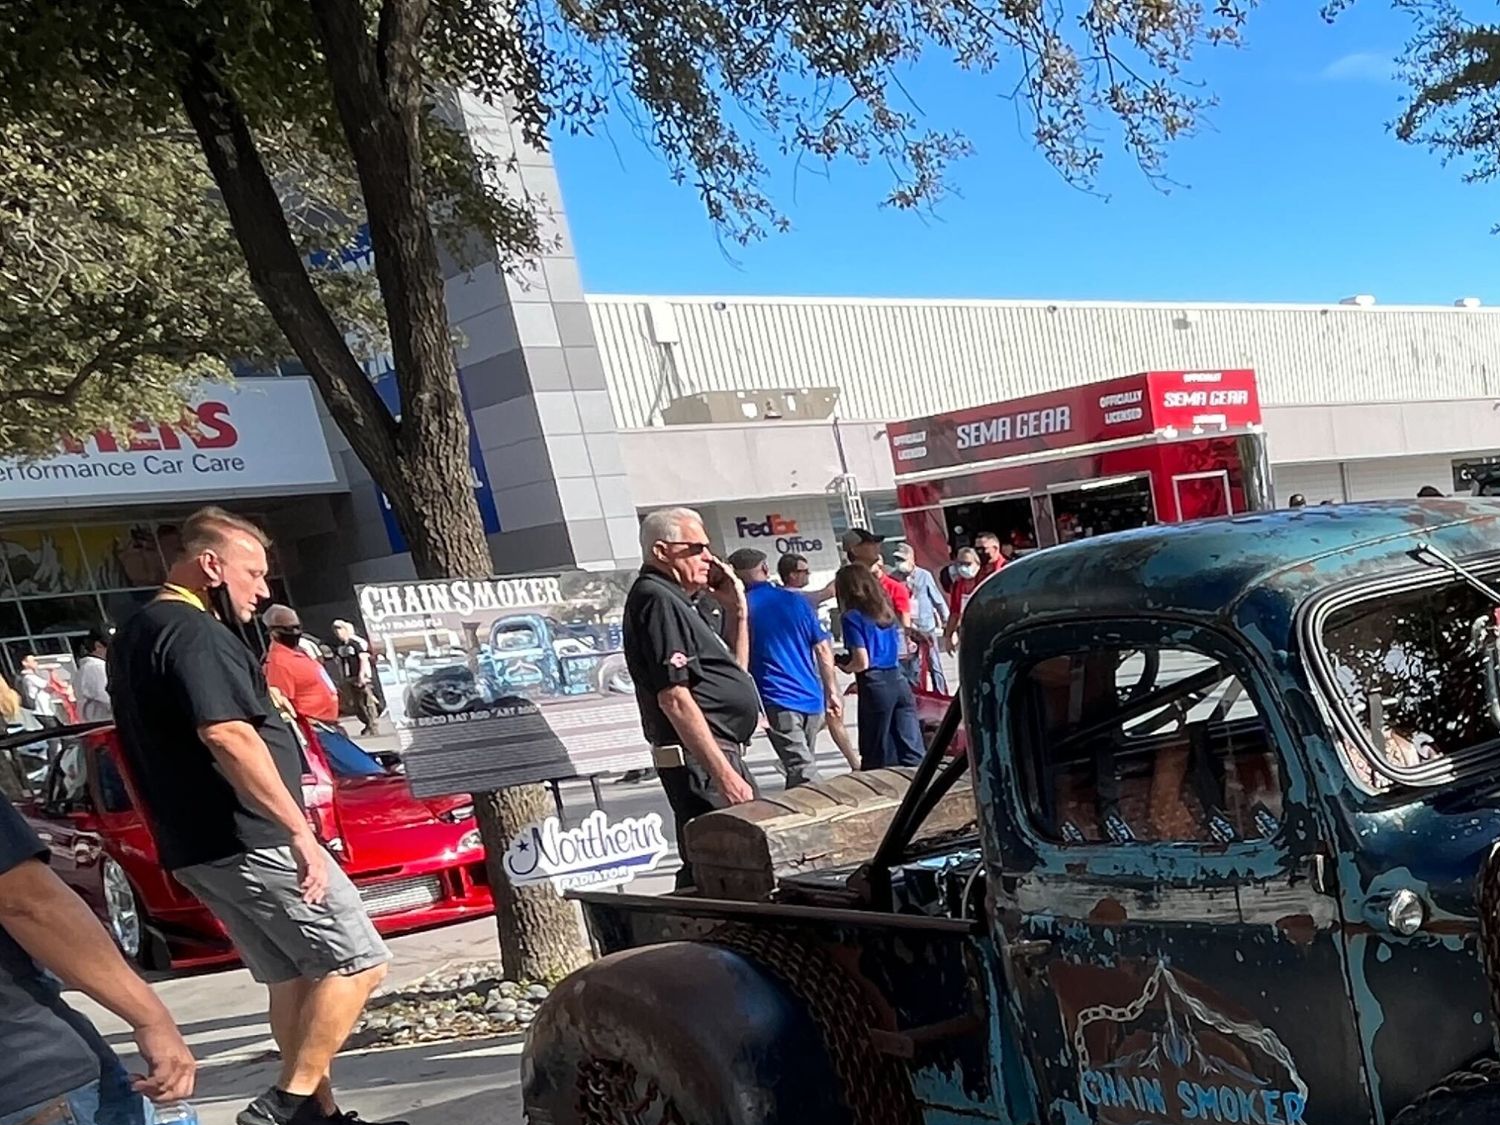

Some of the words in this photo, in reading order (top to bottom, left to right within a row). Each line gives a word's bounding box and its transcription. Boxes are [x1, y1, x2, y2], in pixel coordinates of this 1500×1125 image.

[1163, 391, 1206, 407] SEMA
[1210, 390, 1248, 406] GEAR
[957, 417, 1011, 449] SEMA
[1016, 406, 1071, 439] GEAR
[143, 455, 184, 475] Car
[192, 454, 245, 473] Care
[735, 514, 798, 538] FedEx
[776, 536, 822, 554] Office
[508, 816, 662, 875] Northern
[561, 867, 629, 889] RADIATOR
[1081, 1070, 1167, 1116] CHAIN
